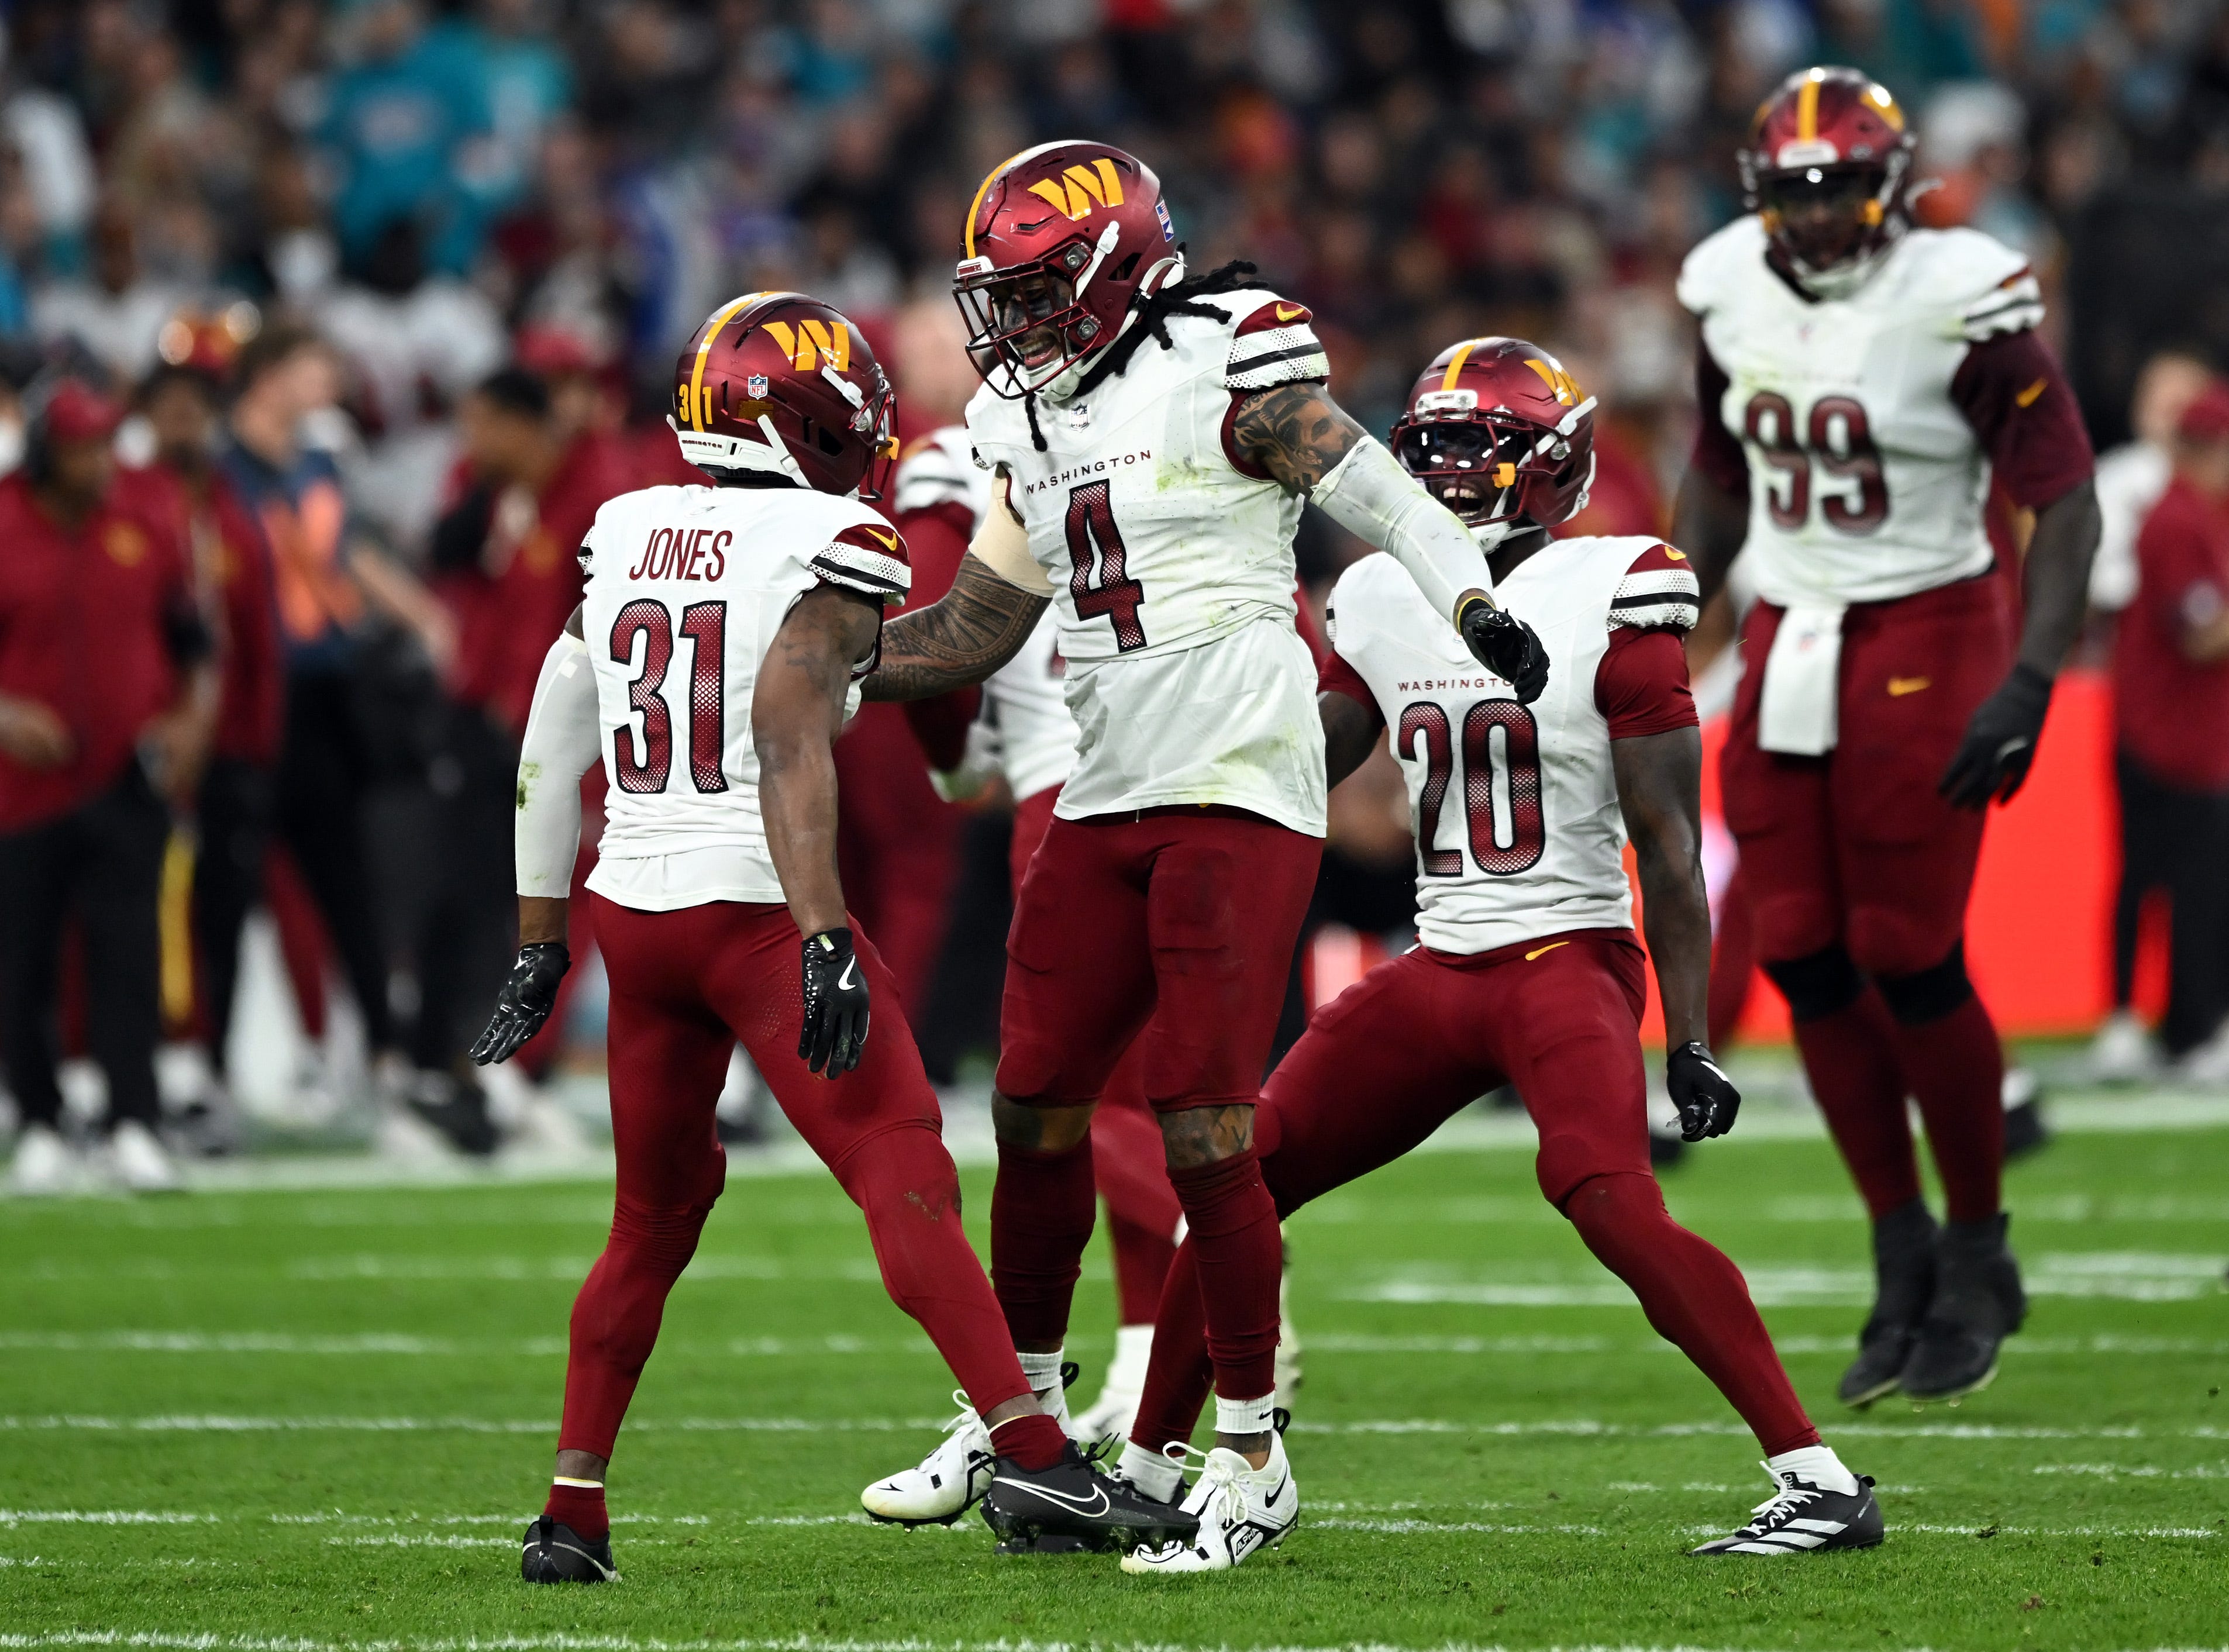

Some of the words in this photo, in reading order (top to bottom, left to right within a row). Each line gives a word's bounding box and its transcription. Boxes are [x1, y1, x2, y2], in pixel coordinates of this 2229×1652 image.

[752, 385, 766, 395] NFL
[1025, 450, 1151, 495] WASHINGTON
[1744, 389, 1890, 537] 99
[629, 527, 733, 582] JONES
[1064, 478, 1148, 653] 4
[609, 598, 729, 794] 31
[1397, 678, 1513, 692] WASHINGTO
[1398, 698, 1546, 878] 20
[1236, 1527, 1259, 1554] ALPHA
